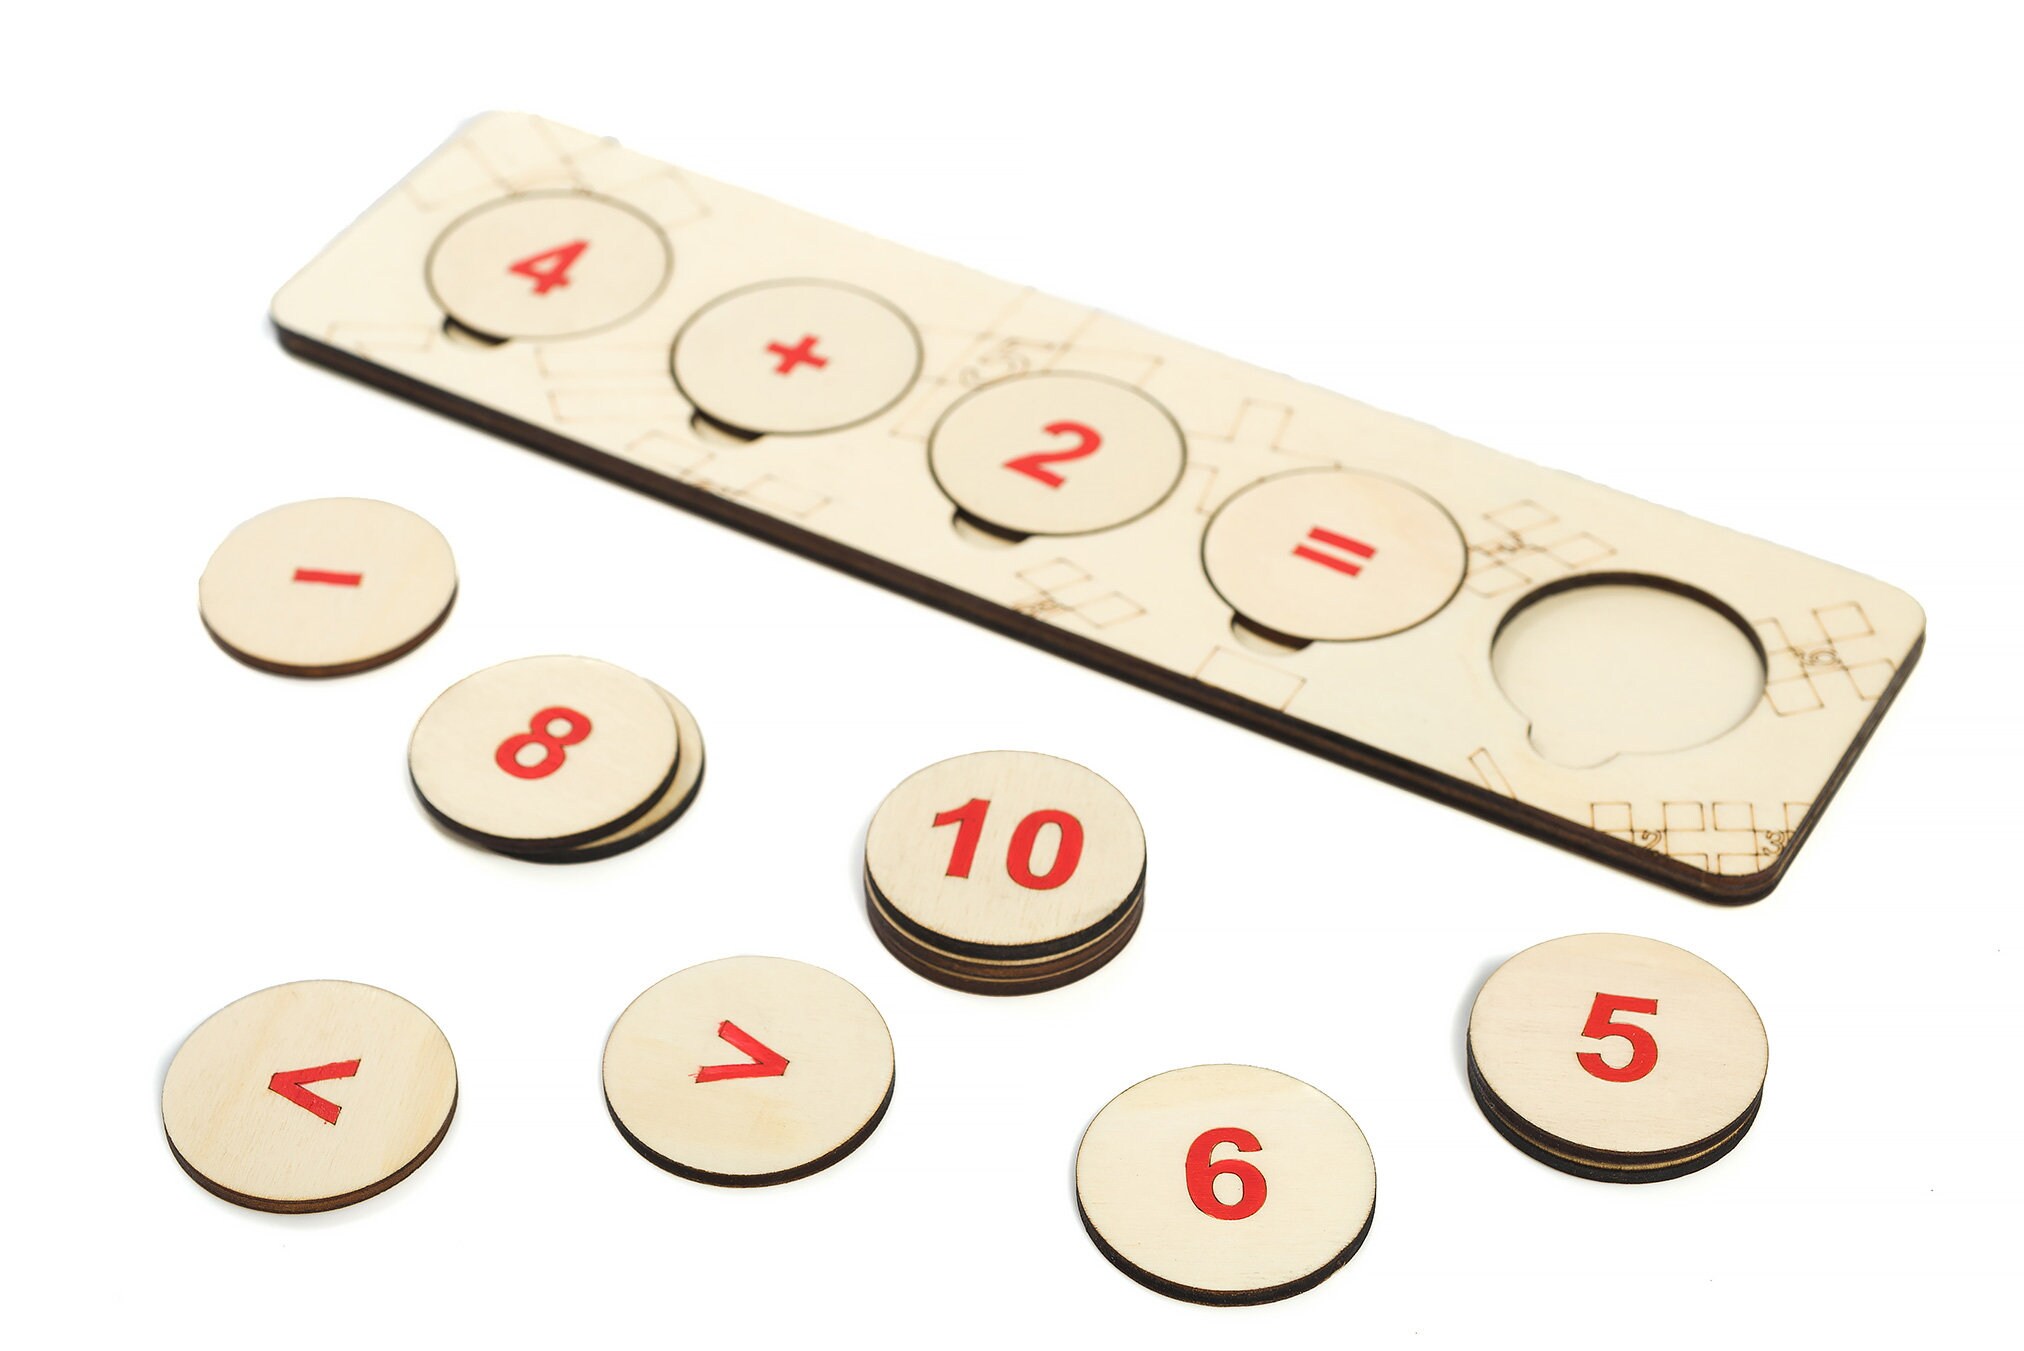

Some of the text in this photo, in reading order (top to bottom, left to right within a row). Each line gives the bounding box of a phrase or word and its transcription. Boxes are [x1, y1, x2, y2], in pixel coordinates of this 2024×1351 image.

[507, 239, 1378, 578] 4 + 2 =
[494, 705, 594, 782] 8
[931, 798, 1086, 892] 10
[694, 1019, 790, 1085] >
[1577, 991, 1660, 1084] 5
[269, 1058, 361, 1125] <
[1183, 1126, 1269, 1222] 6
